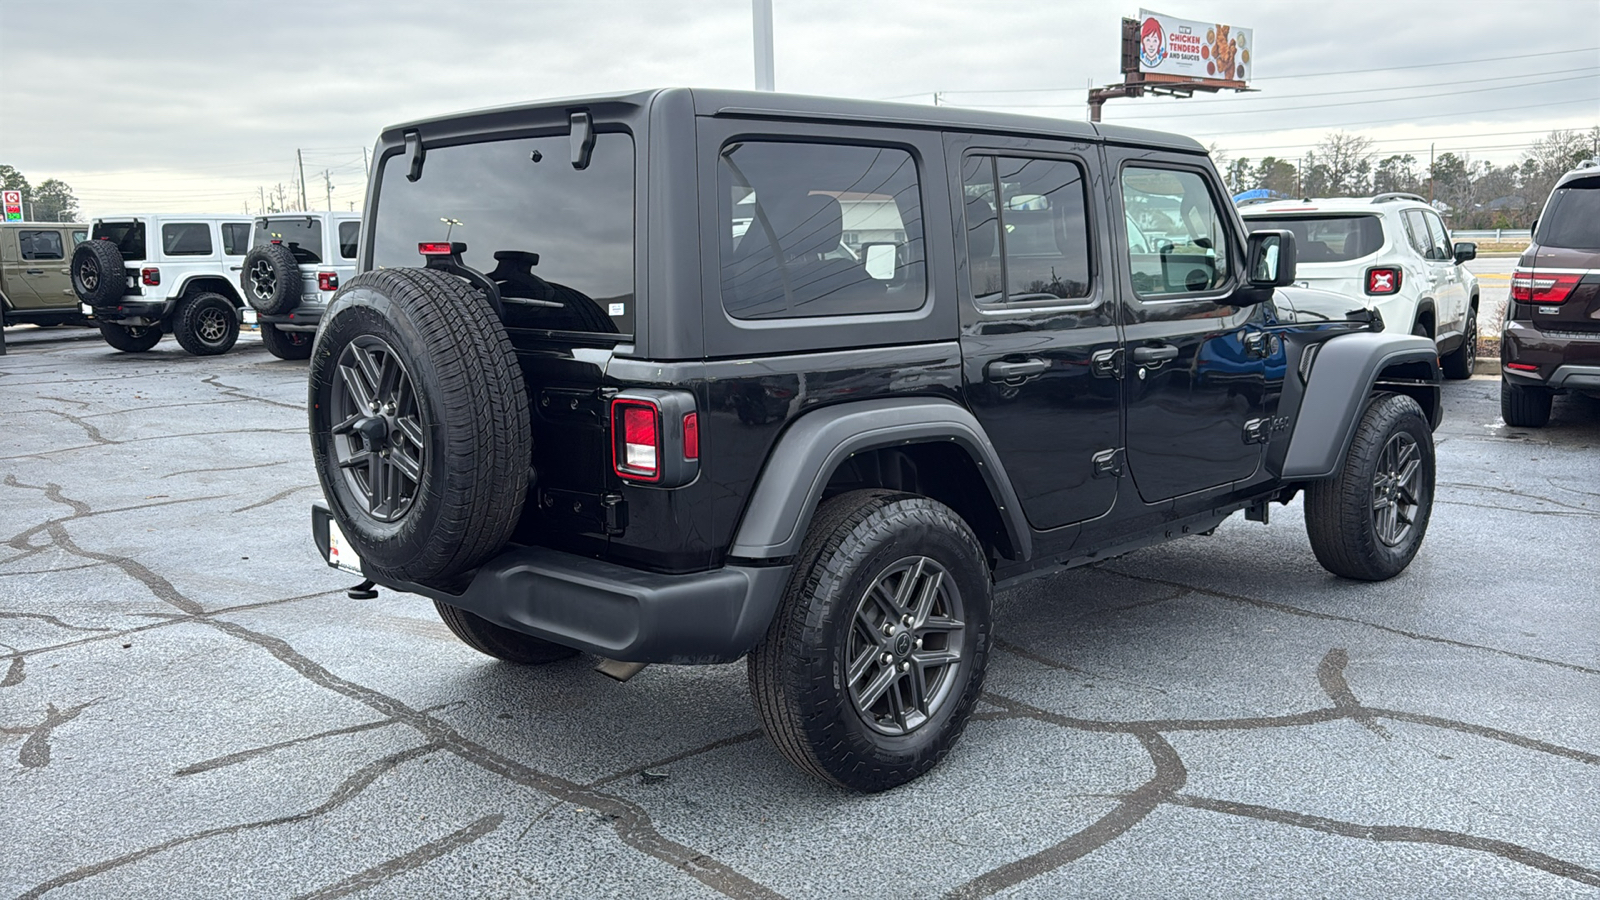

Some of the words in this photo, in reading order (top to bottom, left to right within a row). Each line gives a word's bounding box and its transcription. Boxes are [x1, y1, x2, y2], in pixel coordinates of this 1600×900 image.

[1169, 33, 1200, 44] CHICKEN
[1169, 43, 1200, 53] TENDERS
[1270, 415, 1289, 432] Jeep
